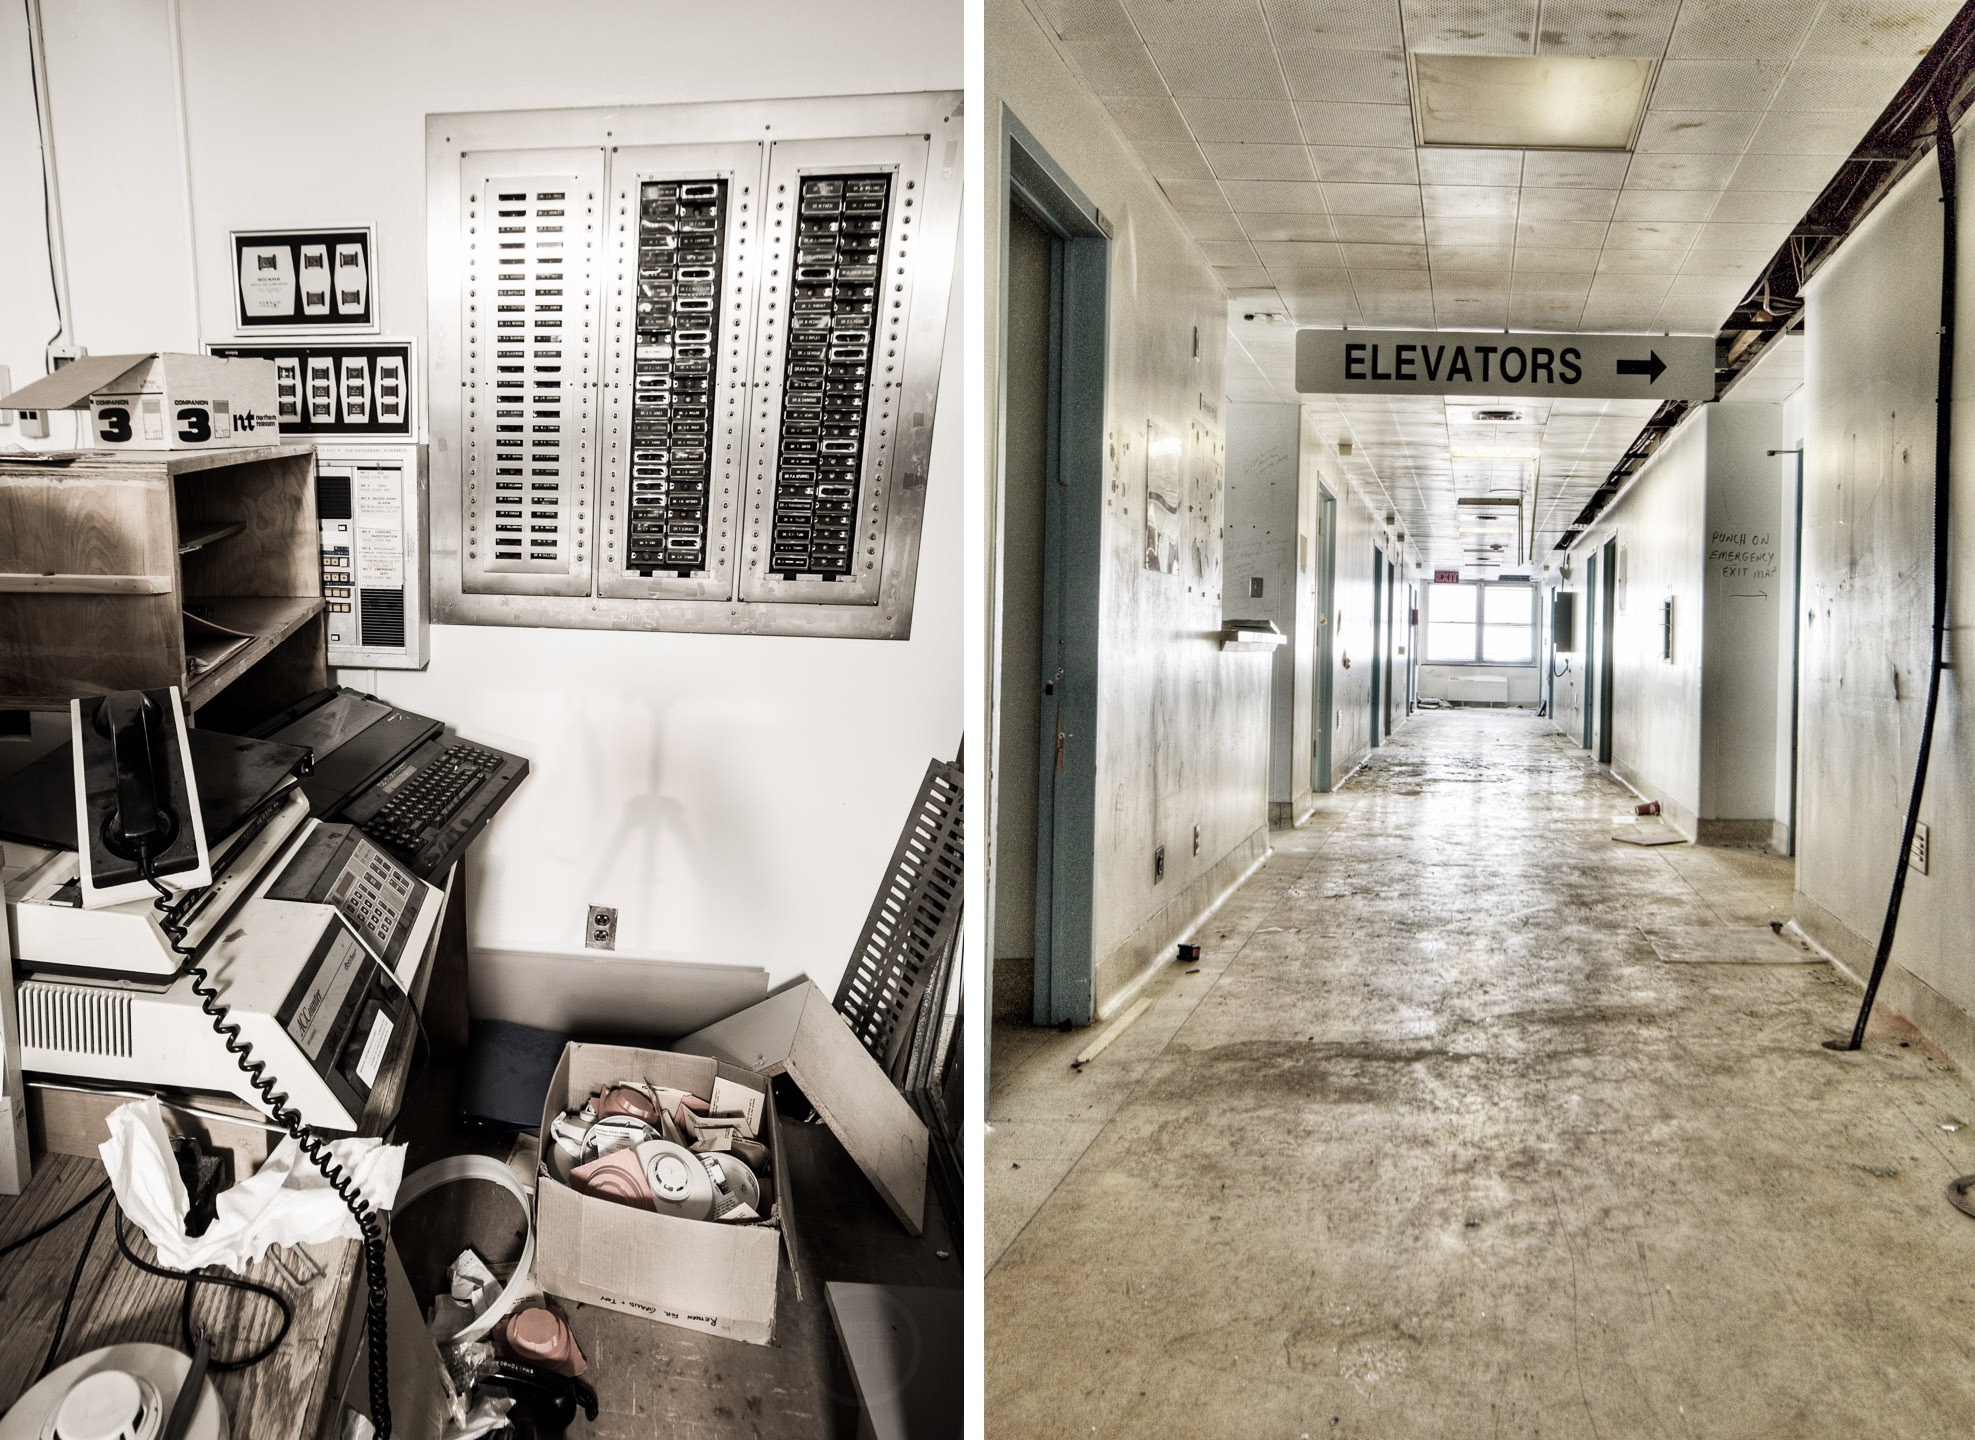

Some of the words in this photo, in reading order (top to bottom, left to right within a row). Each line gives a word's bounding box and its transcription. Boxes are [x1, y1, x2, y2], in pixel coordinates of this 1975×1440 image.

[1344, 343, 1582, 385] ELEVATORS
[98, 408, 133, 443] 3
[177, 408, 211, 443] 3
[233, 409, 255, 432] nt
[1711, 530, 1747, 547] PUNCH
[1751, 532, 1770, 546] ON
[1708, 550, 1775, 566] EMERGENCY
[1436, 572, 1458, 583] EXIT
[1722, 566, 1748, 578] EXIT
